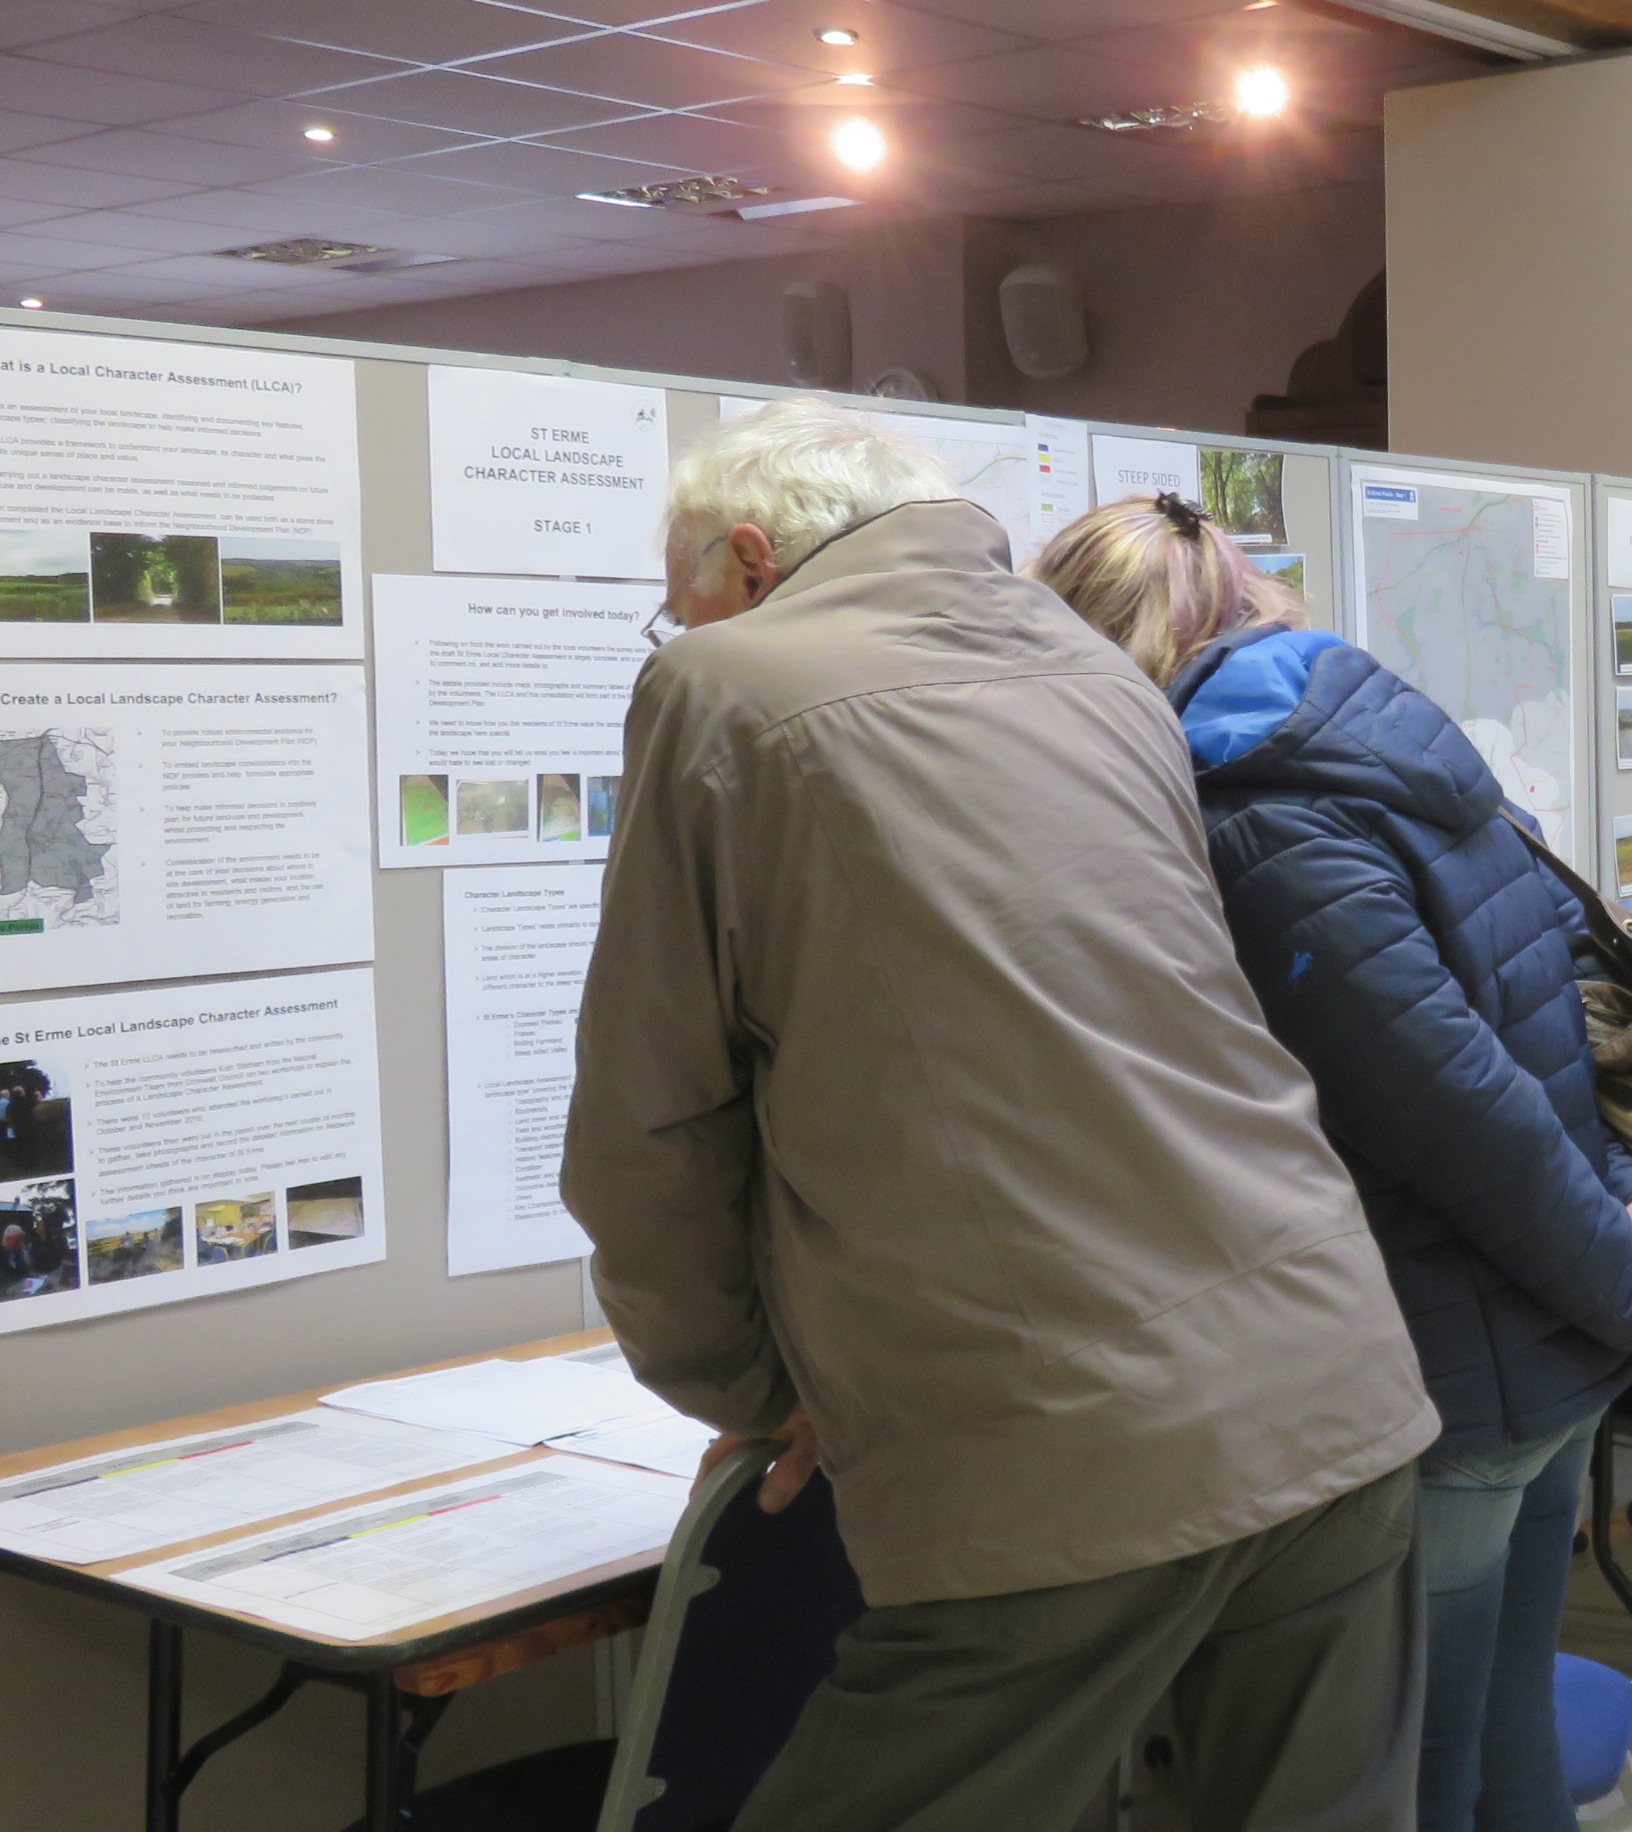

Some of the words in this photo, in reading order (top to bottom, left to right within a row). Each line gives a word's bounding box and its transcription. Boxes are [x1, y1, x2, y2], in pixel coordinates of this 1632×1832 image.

[1, 361, 14, 371] at
[19, 363, 31, 372] is
[37, 364, 44, 373] a
[50, 363, 89, 376] Local
[95, 366, 163, 381] Character
[168, 372, 247, 389] Assessment
[251, 379, 302, 395] (LLCA)?
[531, 427, 548, 440] ST
[552, 429, 589, 444] ERME
[492, 446, 540, 461] LOCAL
[545, 450, 623, 467] LANDSCAPE
[464, 466, 556, 483] CHARACTER
[561, 473, 644, 489] ASSESSMENT
[1118, 470, 1149, 484] STEEP
[1152, 472, 1180, 487] SIDED
[534, 520, 581, 533] STAGE
[586, 523, 592, 534] 1
[468, 603, 493, 614] How
[496, 607, 516, 615] can
[519, 608, 539, 618] you
[543, 608, 559, 619] get
[563, 608, 605, 619] involved
[608, 610, 639, 623] today?
[1, 693, 49, 705] Create
[55, 696, 62, 704] a
[67, 693, 105, 704] Local
[110, 693, 183, 706] Landscape
[188, 693, 250, 704] Character
[255, 693, 337, 703] Assessment?
[544, 889, 564, 897] Types
[15, 1032, 29, 1043] St
[35, 1030, 72, 1042] Erme
[78, 1023, 116, 1037] Local
[121, 1017, 194, 1032] Landscape
[199, 1010, 260, 1024] Character
[264, 999, 338, 1016] Assessment
